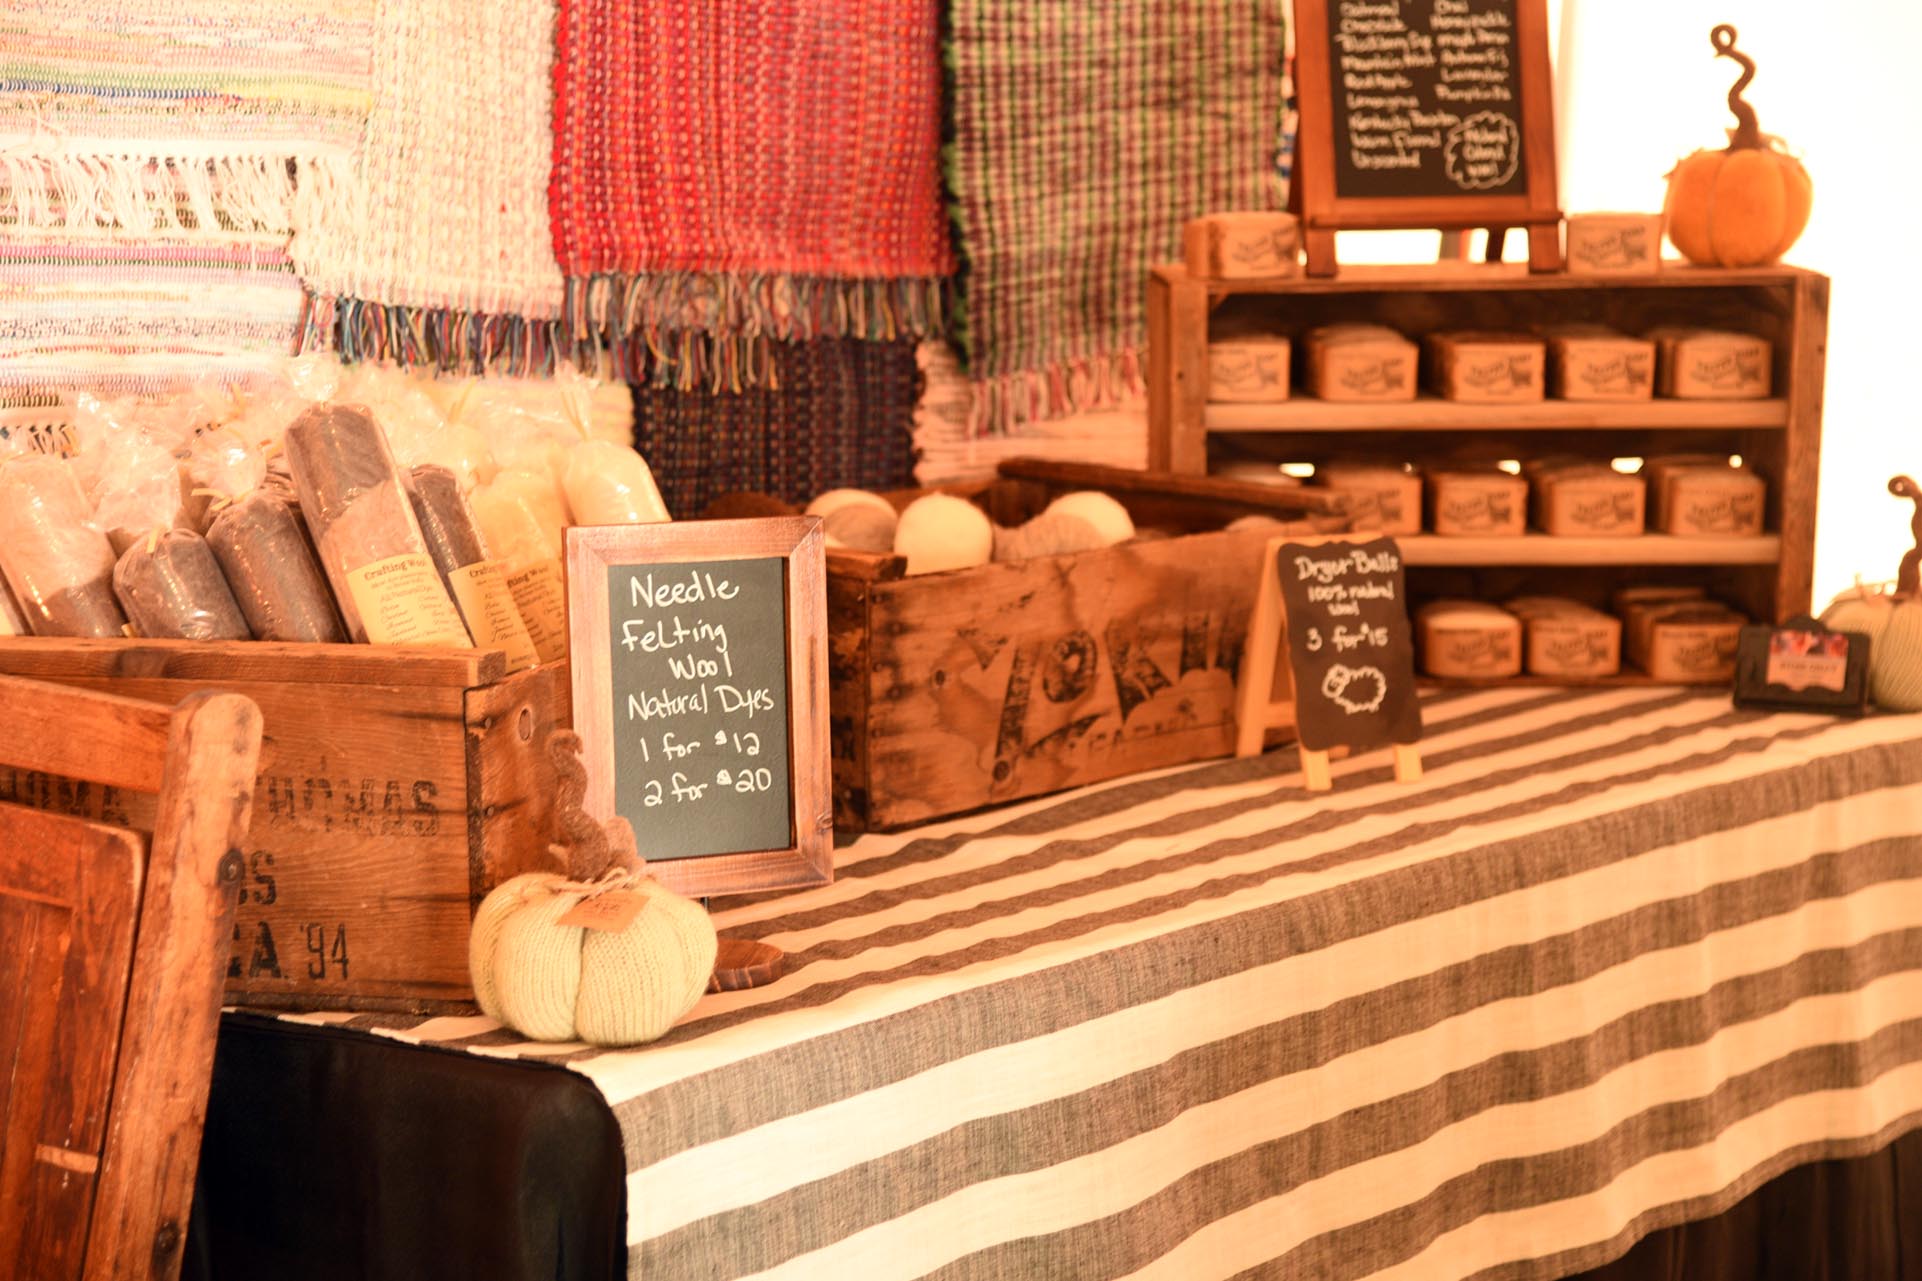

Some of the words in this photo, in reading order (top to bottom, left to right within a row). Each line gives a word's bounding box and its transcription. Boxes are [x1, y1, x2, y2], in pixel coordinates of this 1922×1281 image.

[629, 570, 740, 609] Needle
[1306, 627, 1323, 652] 3
[1331, 624, 1365, 653] for
[668, 650, 733, 681] Wool
[628, 684, 709, 721] Natural
[713, 685, 775, 719] Dyes
[640, 738, 650, 763] 1
[662, 732, 701, 761] for
[714, 730, 761, 757] $12
[644, 780, 663, 808] 2
[671, 772, 708, 803] for
[716, 768, 772, 794] $20
